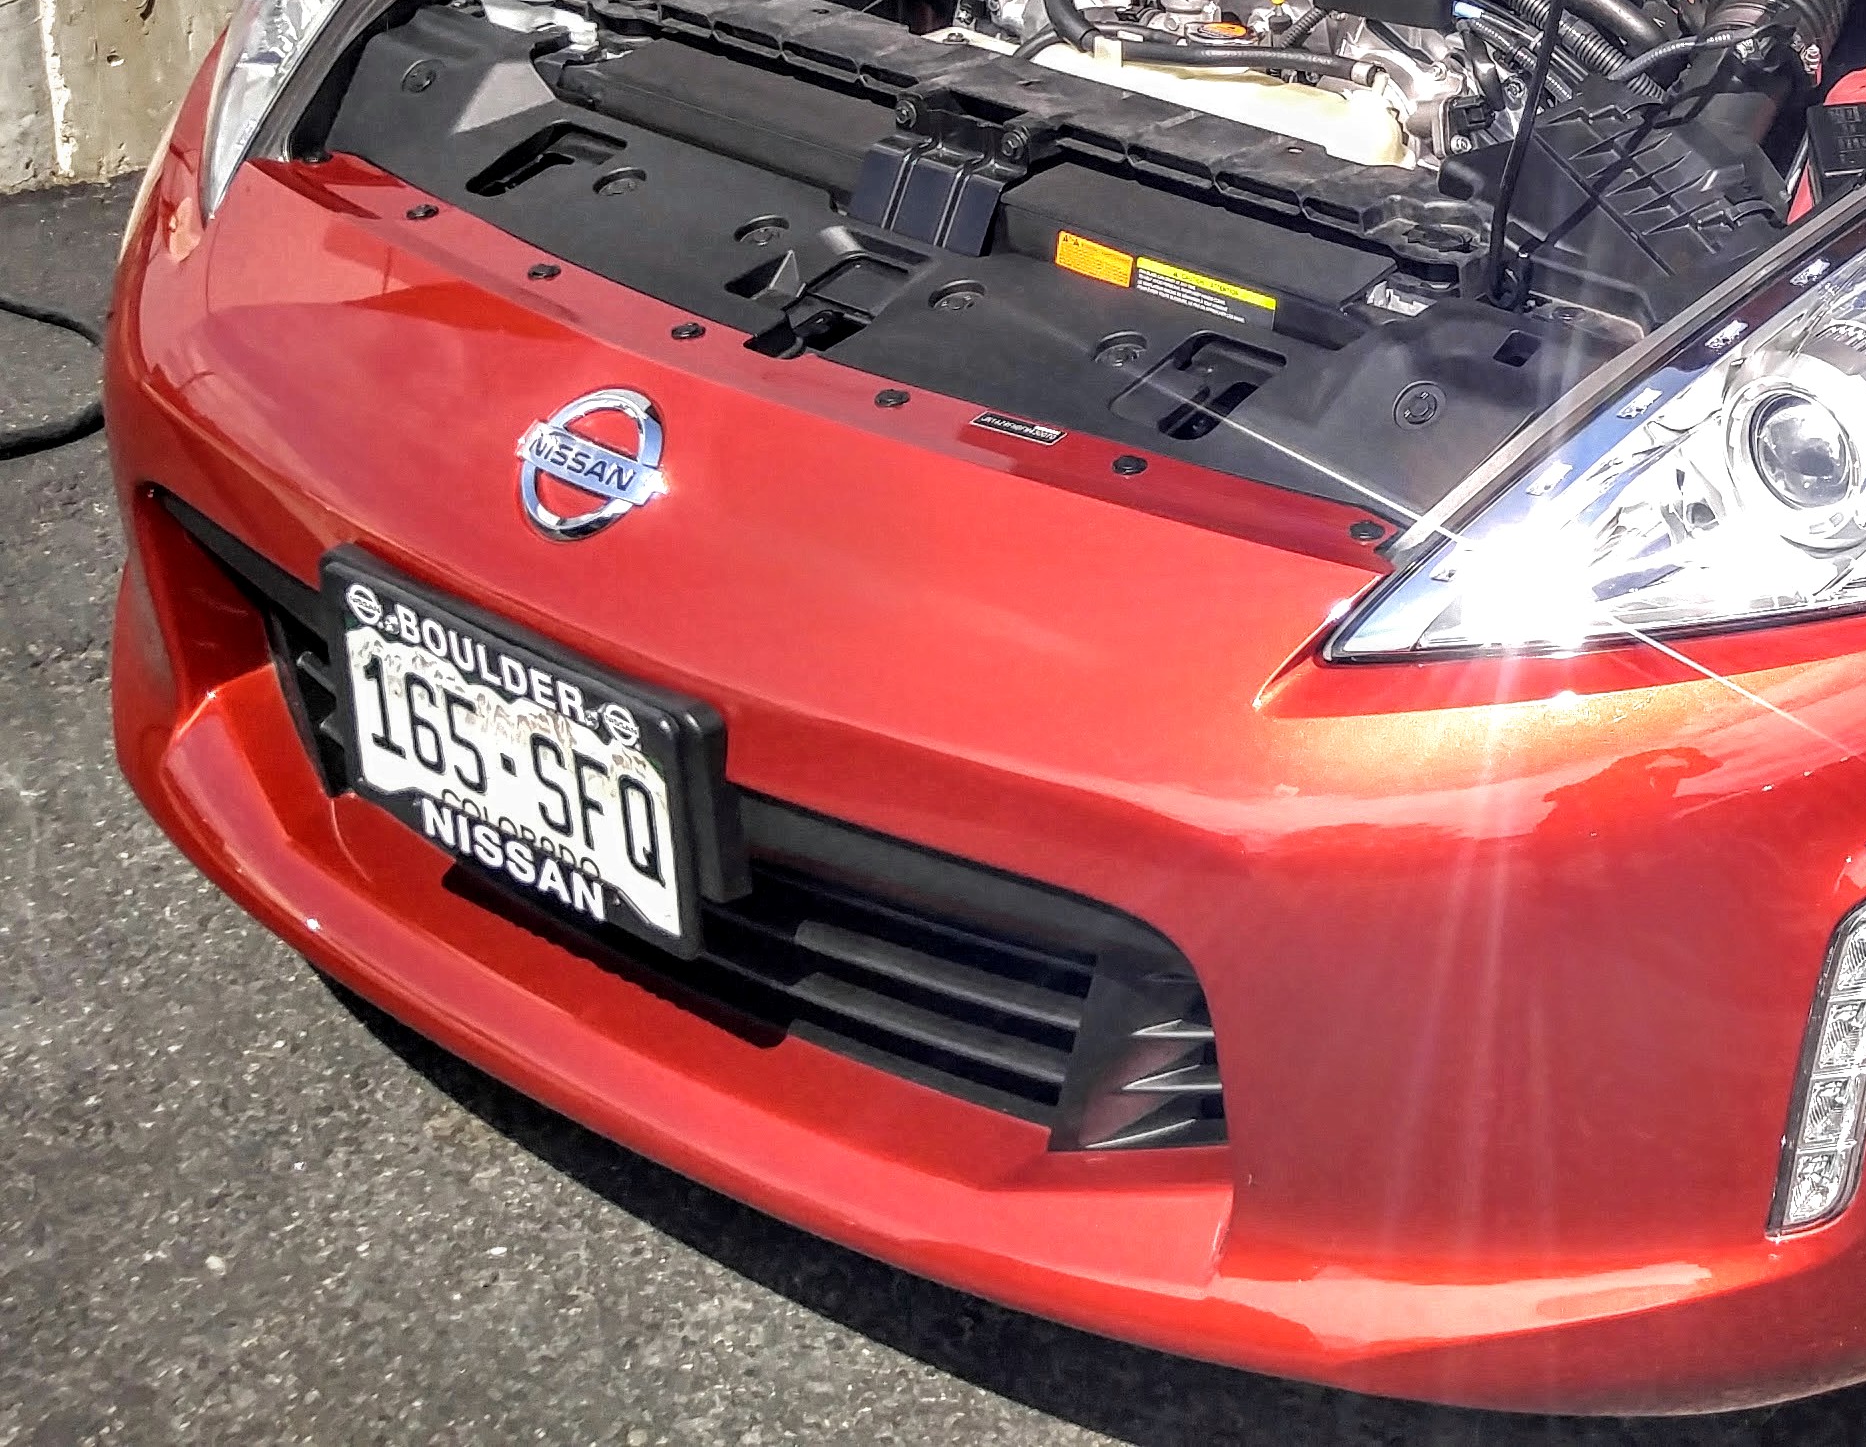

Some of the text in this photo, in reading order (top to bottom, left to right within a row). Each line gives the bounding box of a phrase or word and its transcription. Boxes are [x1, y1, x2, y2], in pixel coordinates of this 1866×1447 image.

[528, 432, 637, 492] NISSAN
[395, 603, 587, 724] BOULDER
[421, 797, 606, 921] NISSAN
